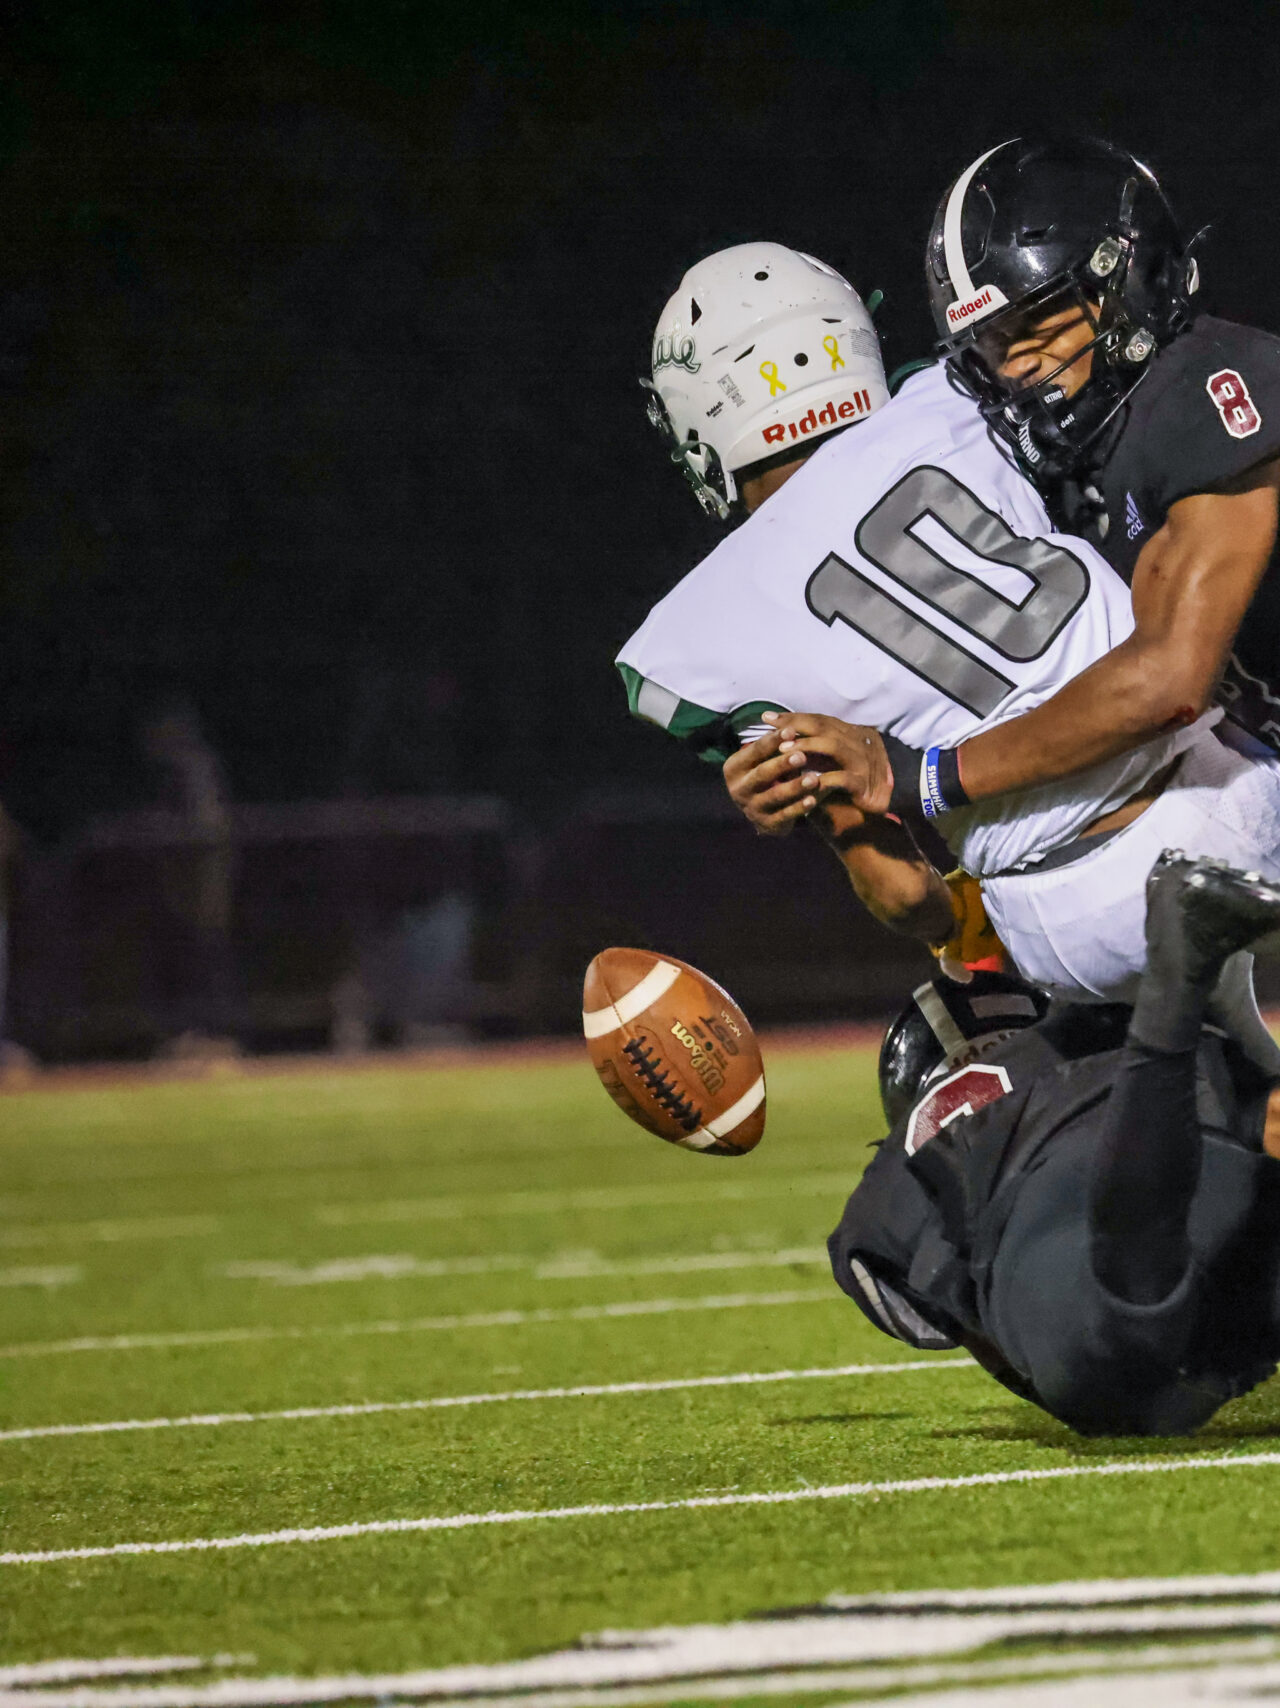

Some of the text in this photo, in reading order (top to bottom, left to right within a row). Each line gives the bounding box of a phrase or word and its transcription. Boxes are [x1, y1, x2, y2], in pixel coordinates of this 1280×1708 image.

[762, 389, 872, 444] Riddell
[1206, 368, 1262, 439] 8
[1018, 421, 1041, 464] XTRND
[804, 464, 1091, 720] 10
[670, 1020, 726, 1096] Wilson
